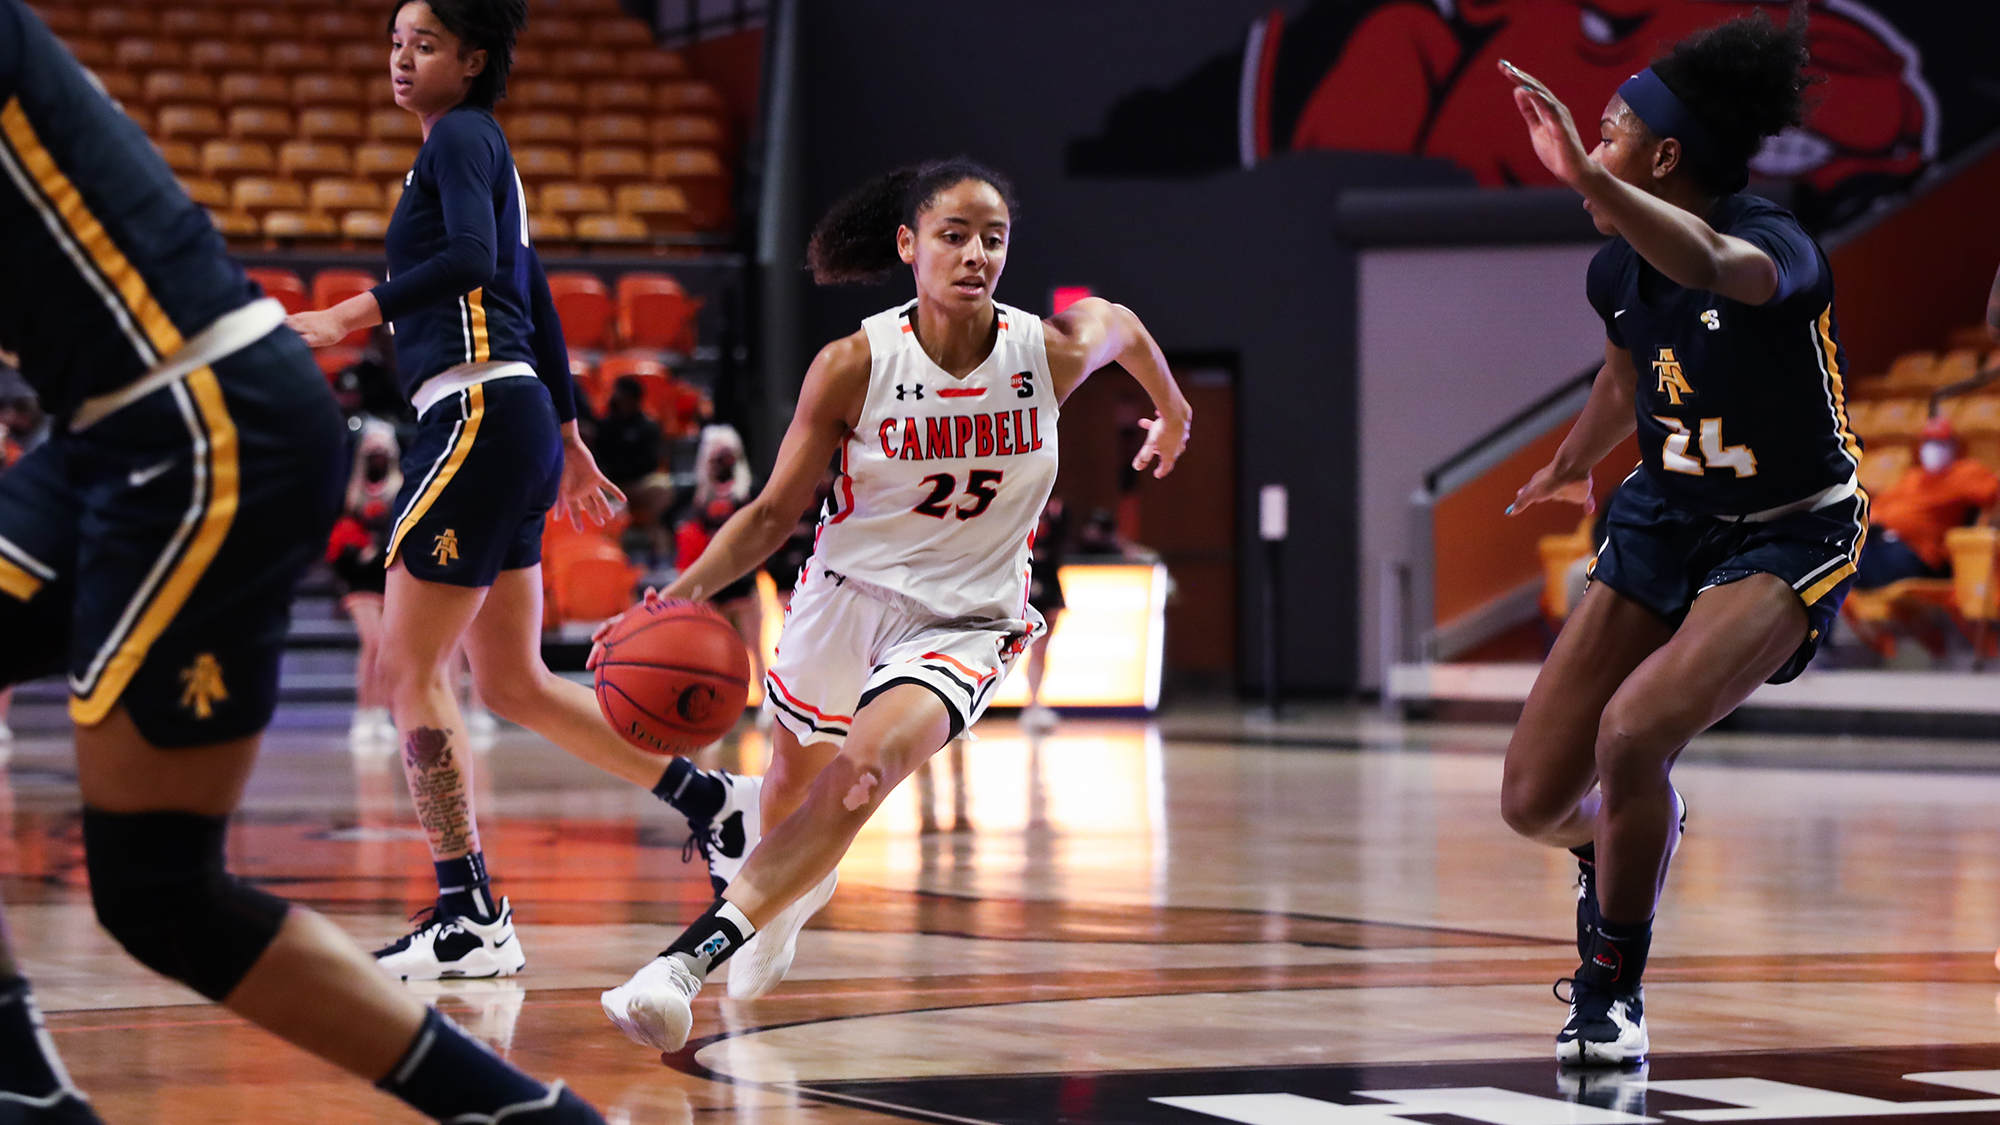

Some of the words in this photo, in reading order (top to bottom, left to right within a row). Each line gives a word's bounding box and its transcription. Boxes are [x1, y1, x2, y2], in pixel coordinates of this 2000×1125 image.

[878, 406, 1043, 461] CAMPBELL
[1652, 414, 1758, 478] 24
[912, 469, 1004, 521] 25
